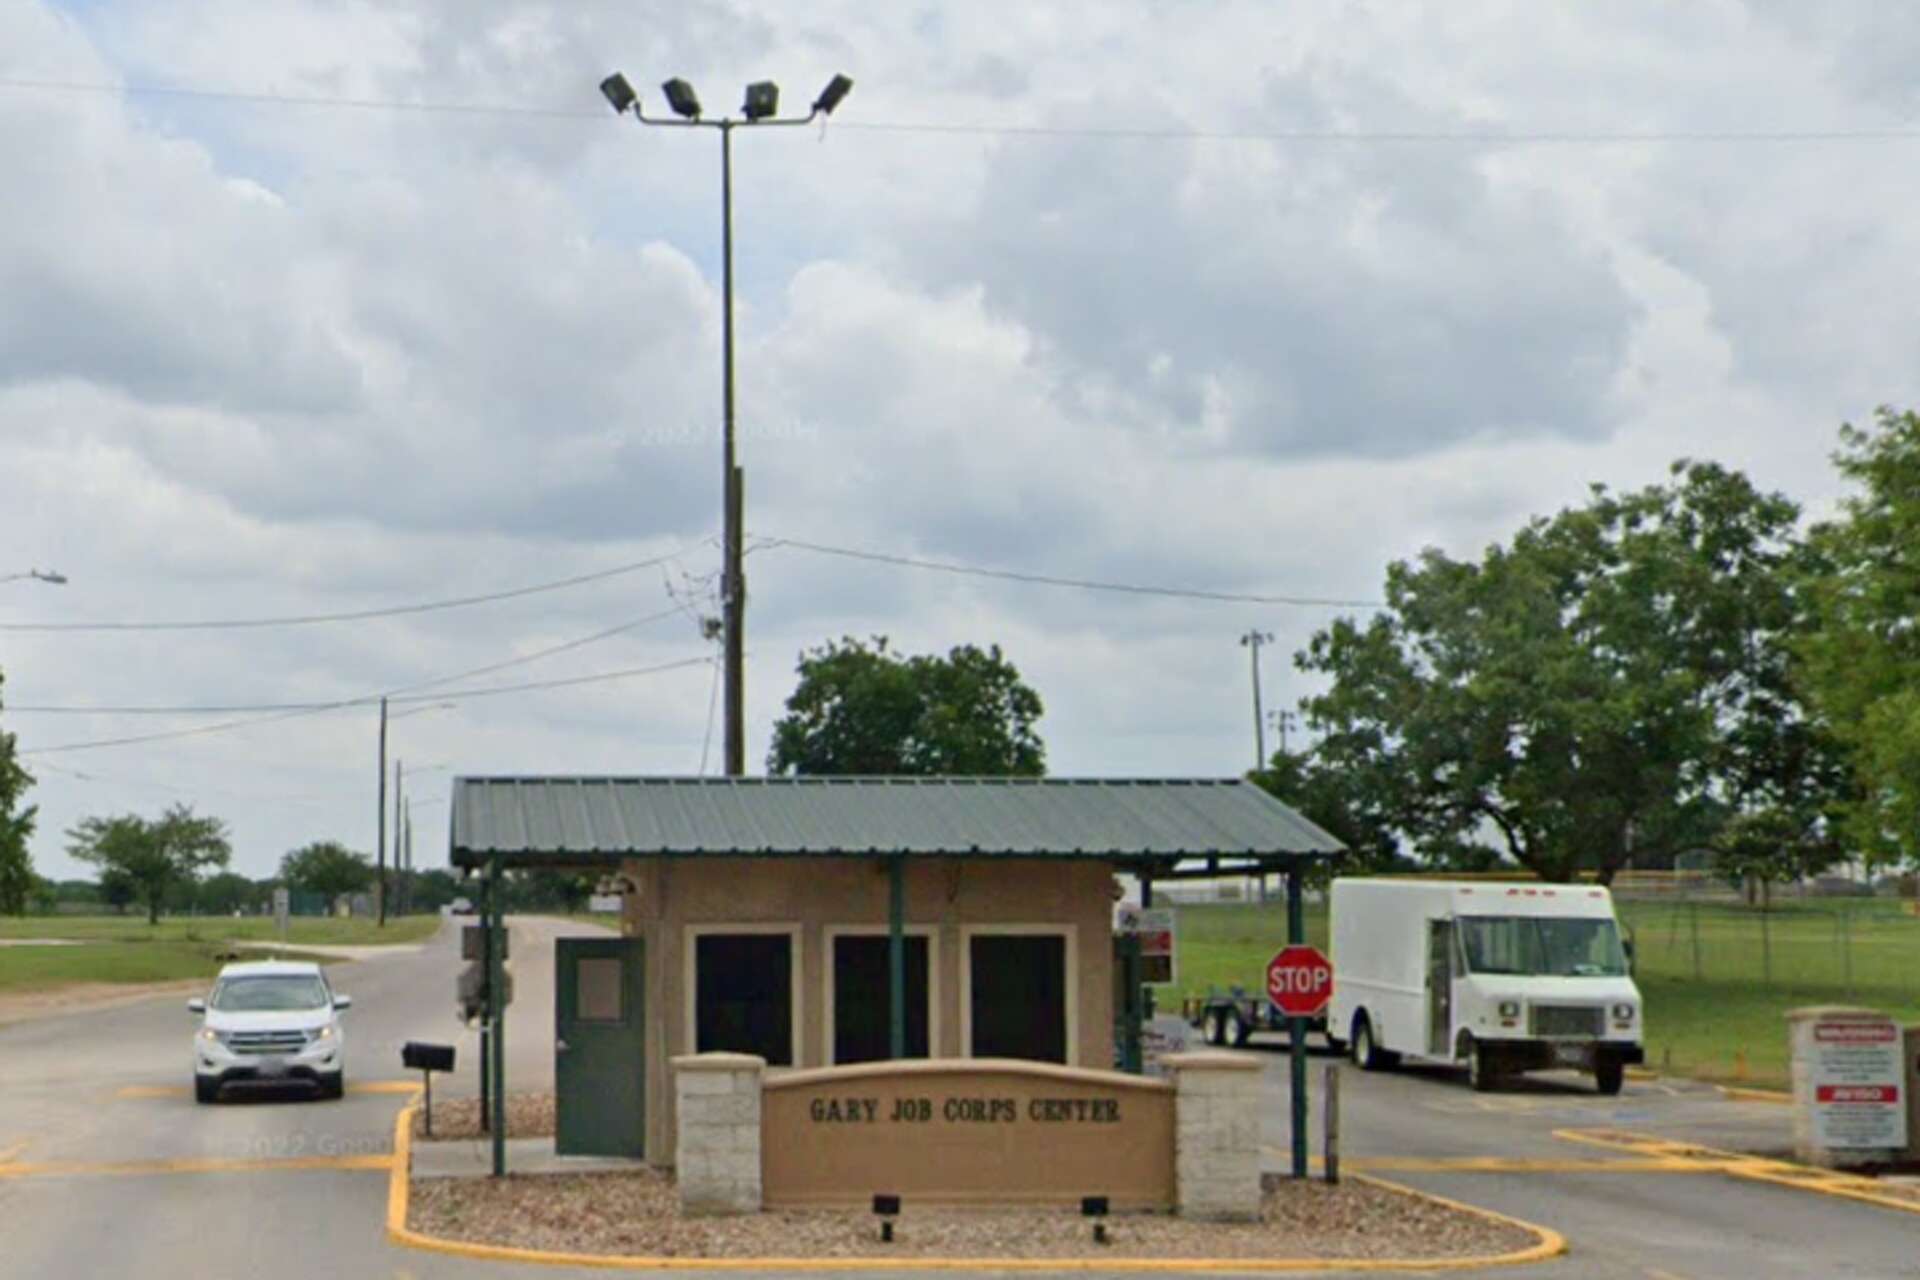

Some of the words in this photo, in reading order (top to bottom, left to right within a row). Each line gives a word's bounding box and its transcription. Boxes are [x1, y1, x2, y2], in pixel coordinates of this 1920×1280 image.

[1269, 965, 1329, 993] STOP
[810, 1098, 879, 1122] GARY
[889, 1098, 932, 1122] JOB
[943, 1098, 1018, 1122] CORPS
[1027, 1098, 1121, 1122] CENTER
